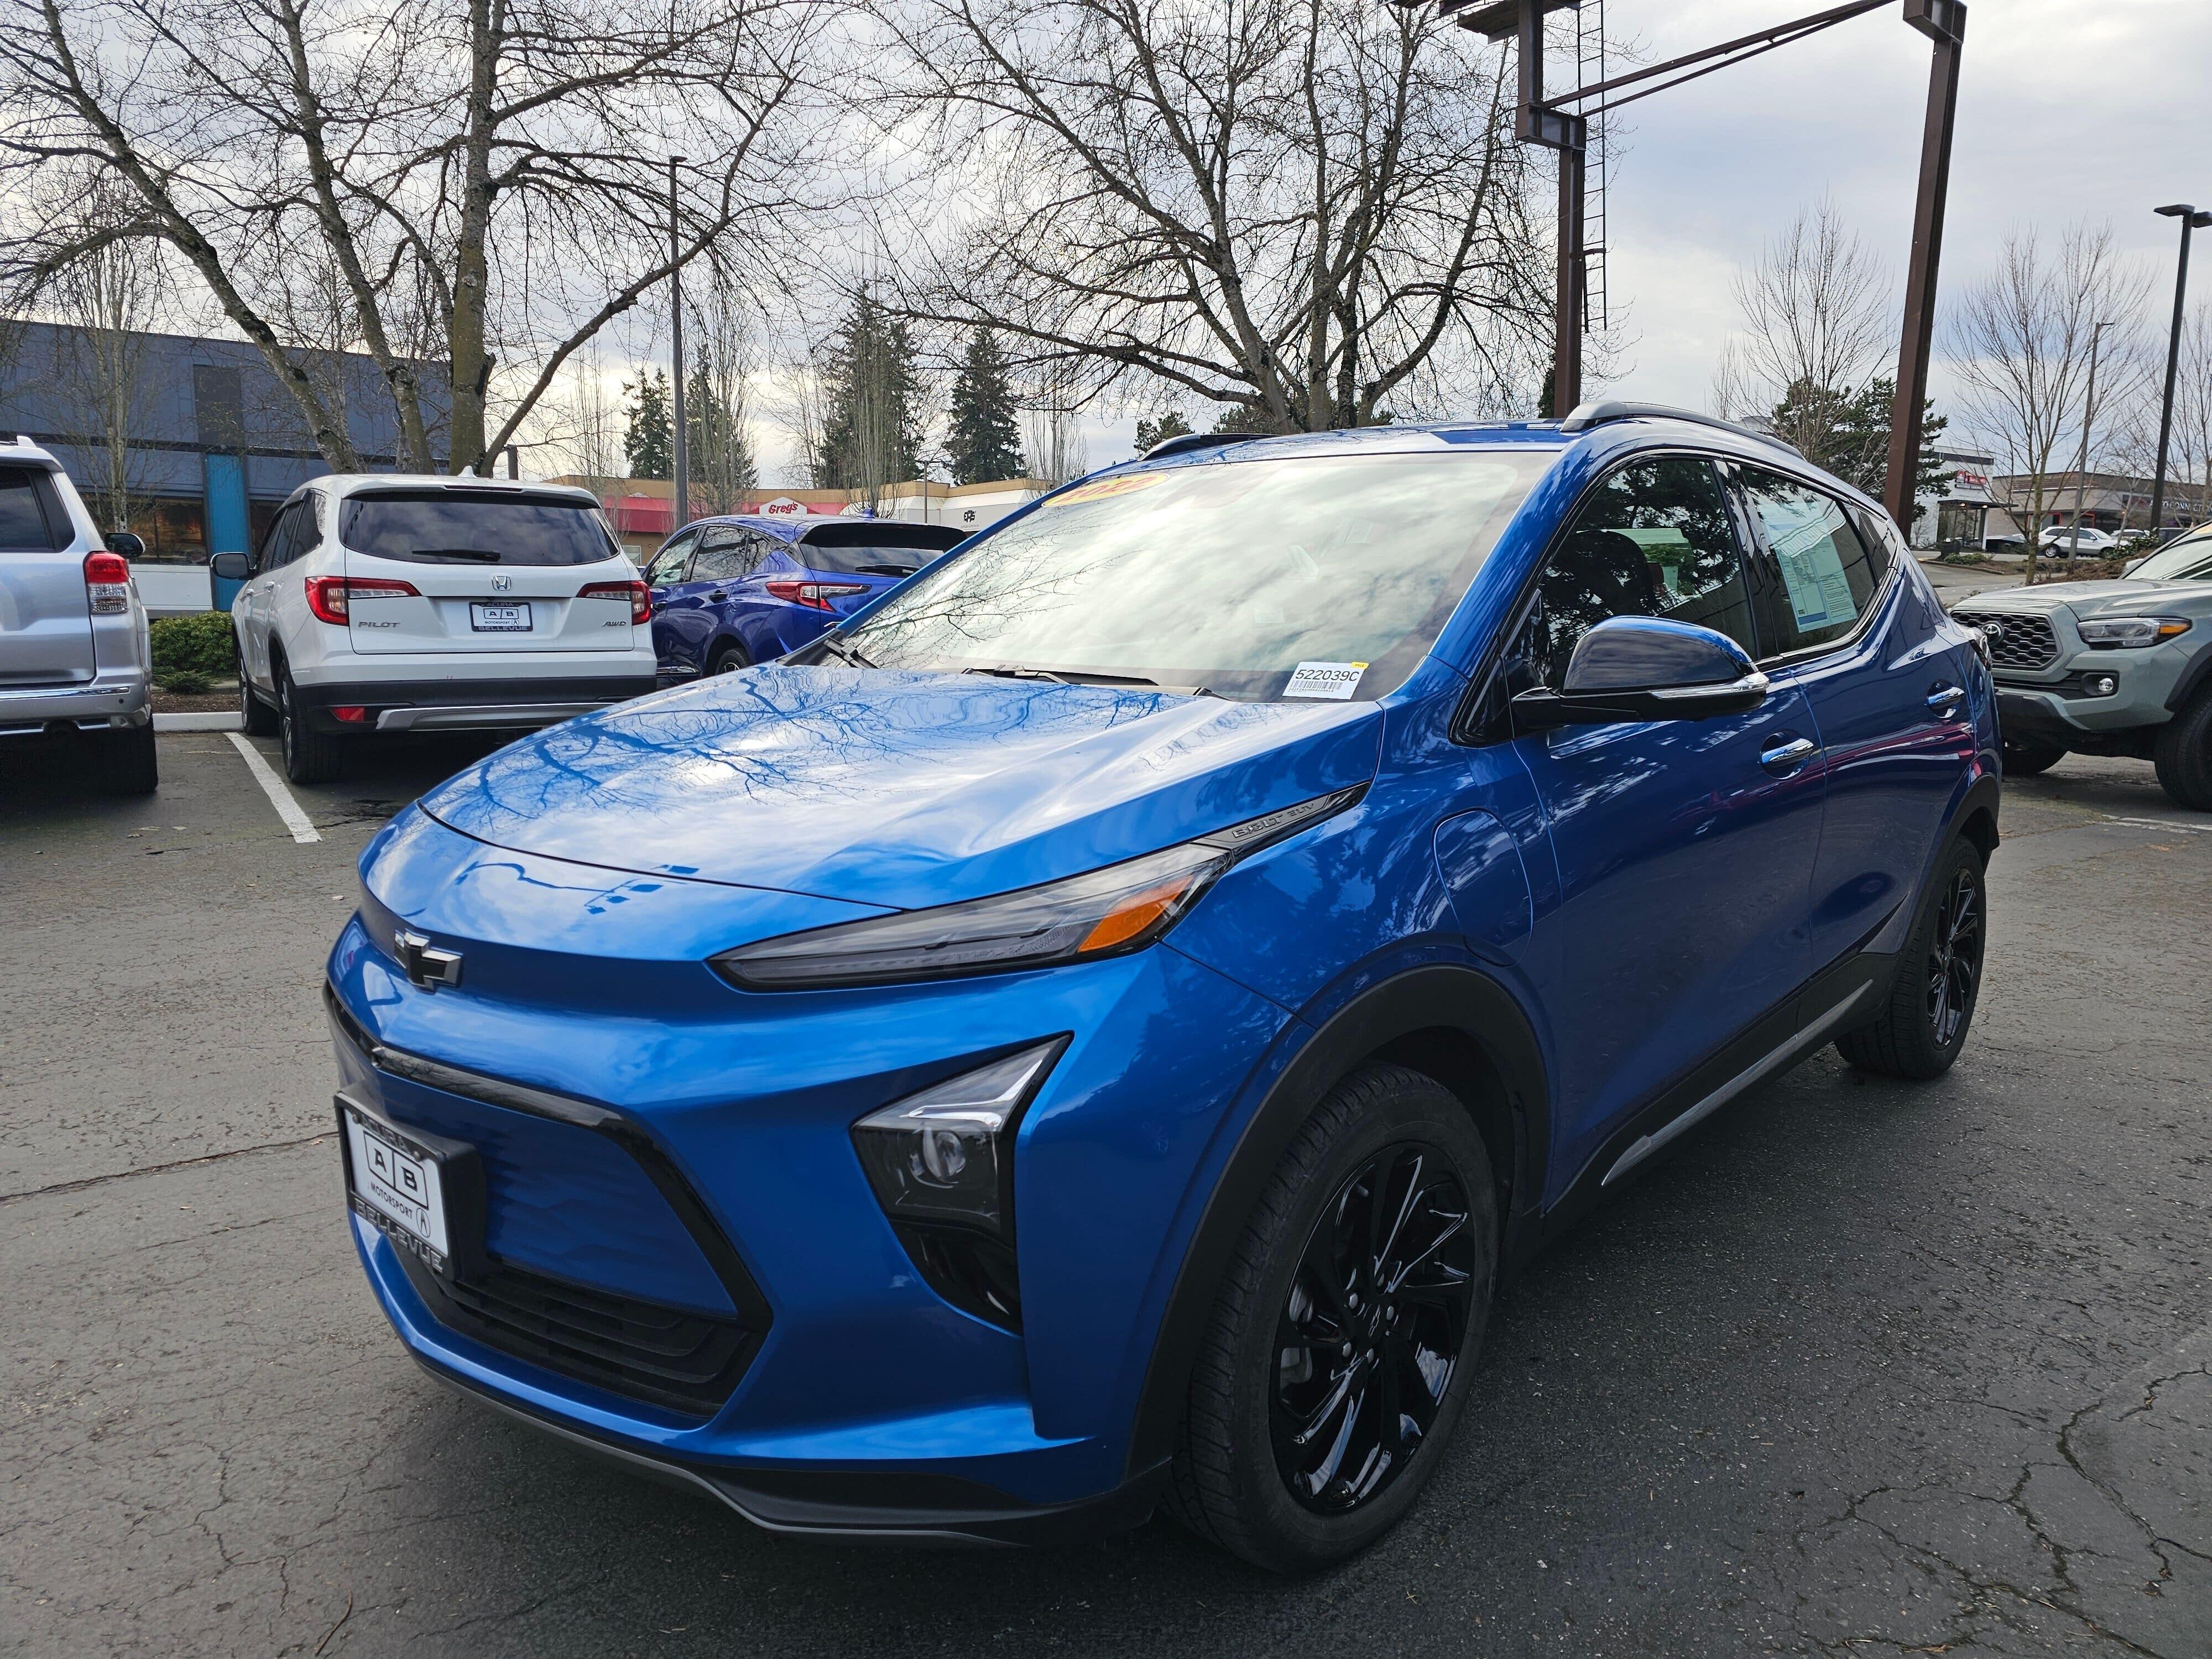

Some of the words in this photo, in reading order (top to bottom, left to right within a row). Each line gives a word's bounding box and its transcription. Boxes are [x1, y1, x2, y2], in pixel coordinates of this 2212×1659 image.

[768, 501, 798, 514] Greg's
[1295, 669, 1359, 681] 522039C
[1232, 814, 1282, 838] BOLT
[1287, 804, 1314, 817] EUV
[362, 1114, 412, 1155] ACURA
[374, 1147, 387, 1173] A
[400, 1166, 418, 1192] B
[371, 1181, 413, 1220] MOTORSPORT
[354, 1197, 443, 1274] BELLEVUE
